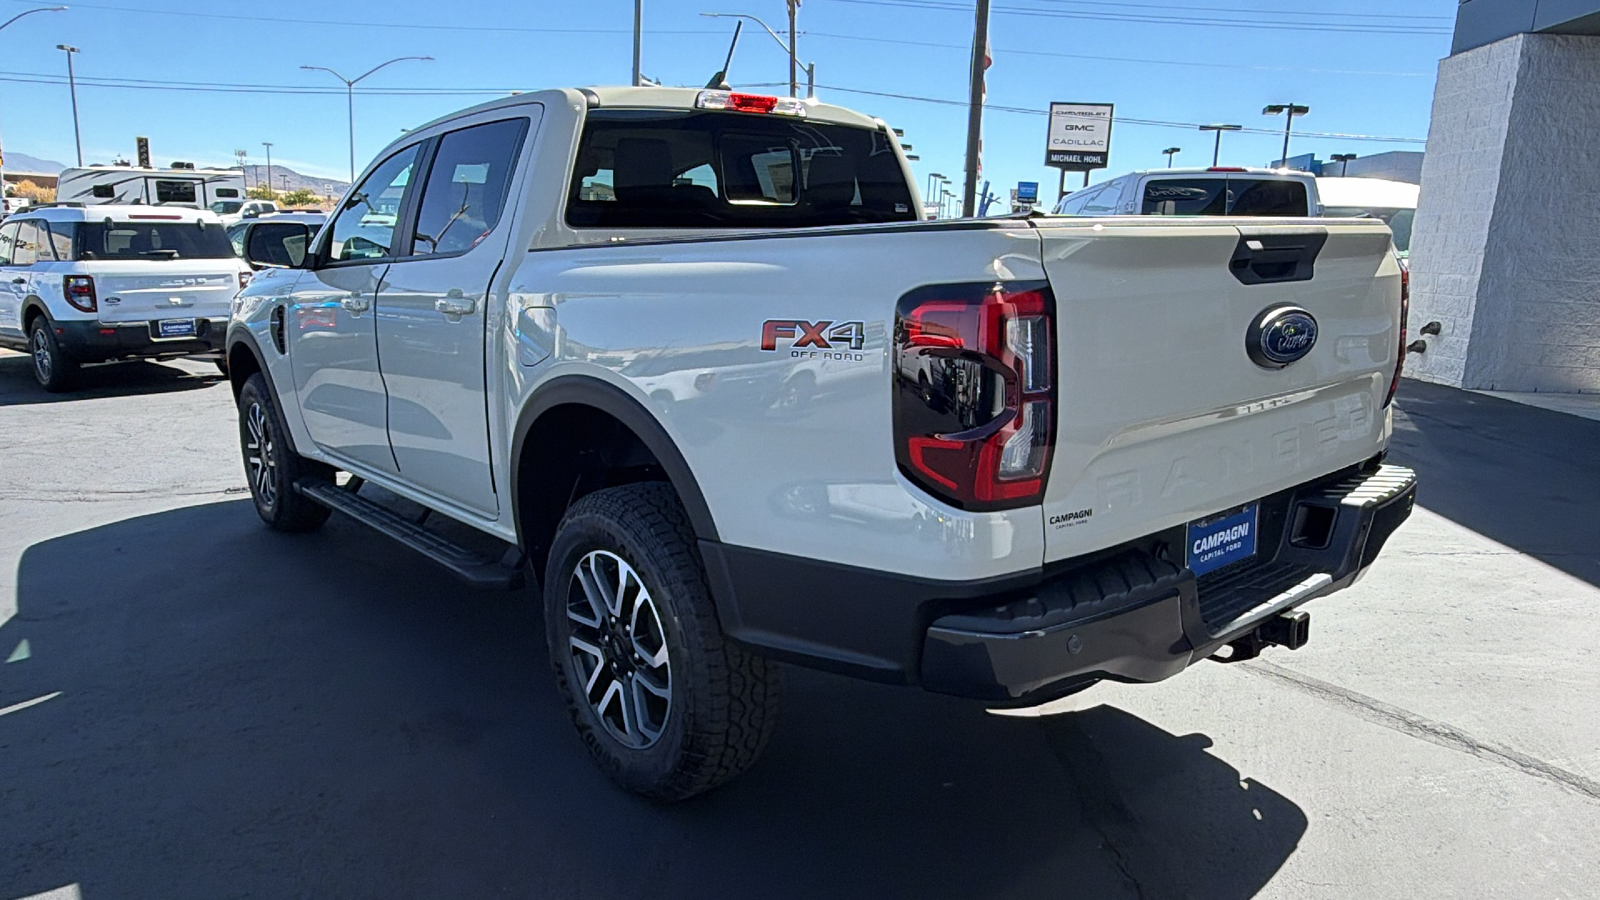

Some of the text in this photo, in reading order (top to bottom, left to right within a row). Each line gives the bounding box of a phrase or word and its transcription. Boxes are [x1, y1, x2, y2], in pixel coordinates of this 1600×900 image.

[1052, 138, 1104, 146] CADILLAC
[1051, 154, 1103, 164] MICHAEL HOHL
[760, 319, 865, 351] FX4
[1278, 322, 1312, 350] Ford
[791, 350, 863, 361] OFF ROAD
[1049, 508, 1093, 525] CAMPAGNI
[1193, 522, 1249, 554] CAMPAGNI
[1199, 541, 1242, 563] CAPITAL FORD
